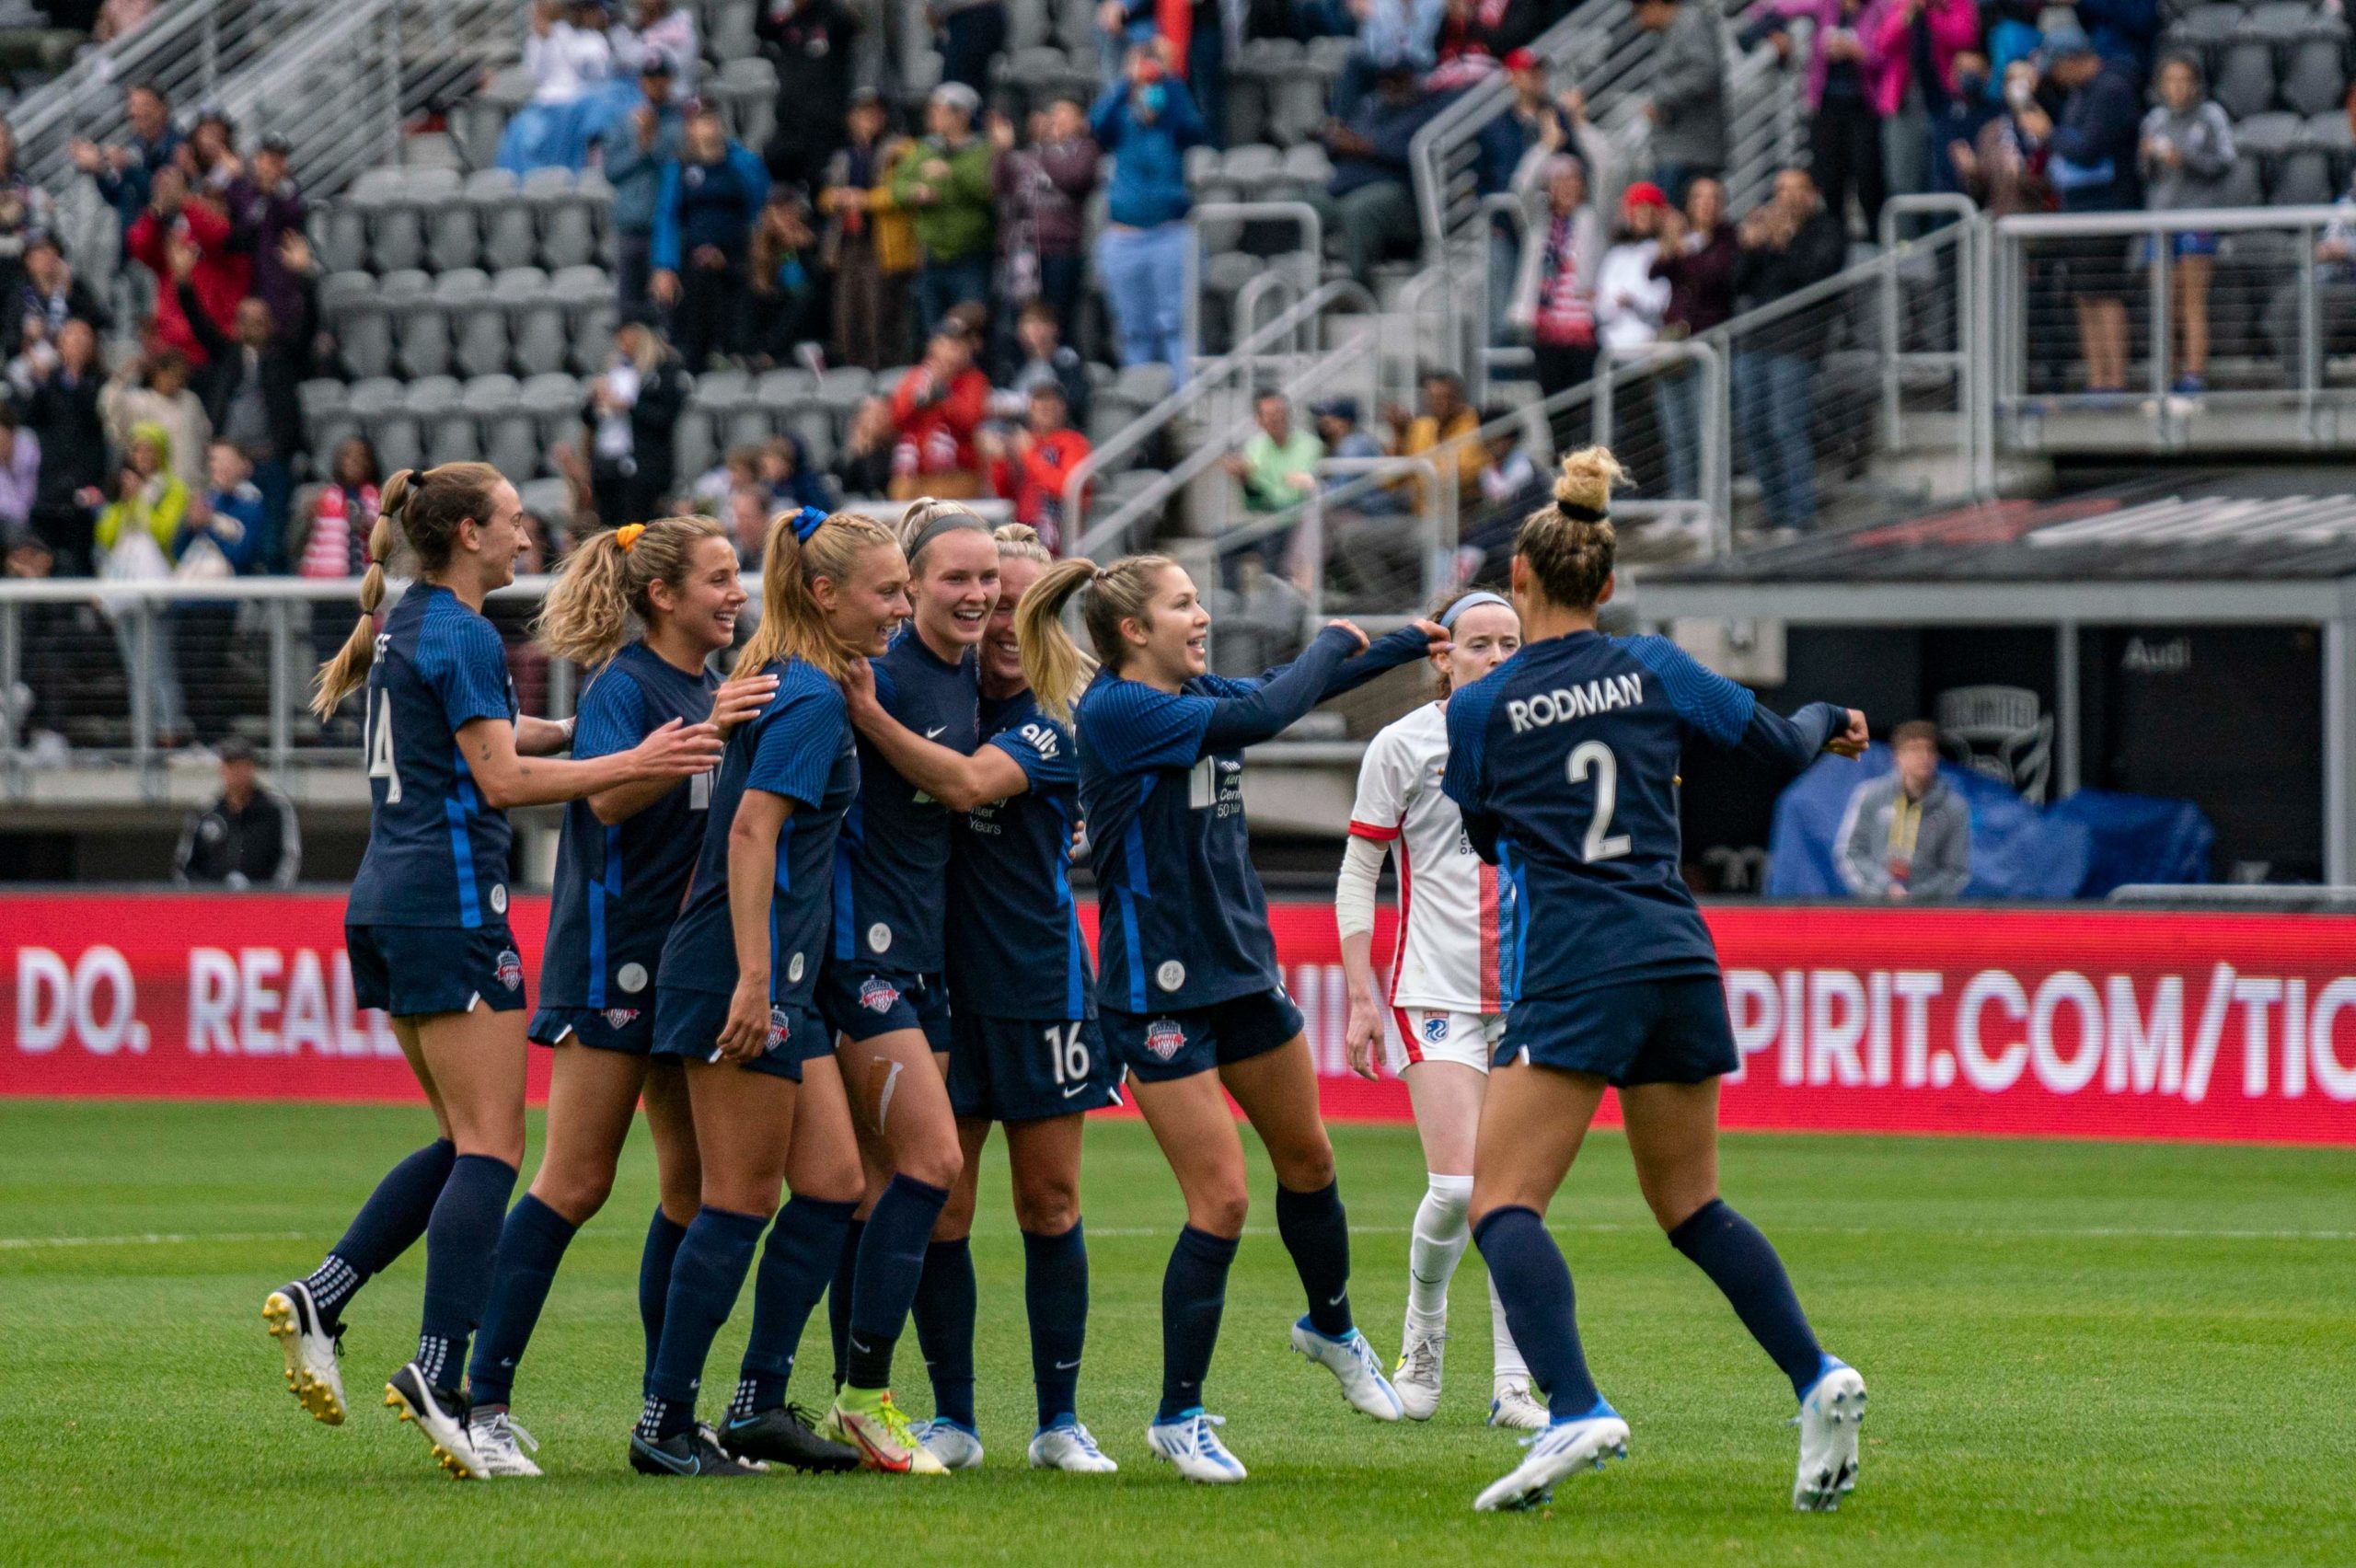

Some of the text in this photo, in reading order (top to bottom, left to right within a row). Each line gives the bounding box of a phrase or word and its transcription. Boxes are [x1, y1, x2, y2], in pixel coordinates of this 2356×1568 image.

[1507, 673, 1644, 734] RODMAN
[1565, 739, 1632, 865] 2
[16, 944, 151, 1055] DO.
[1044, 1020, 1091, 1085] 16
